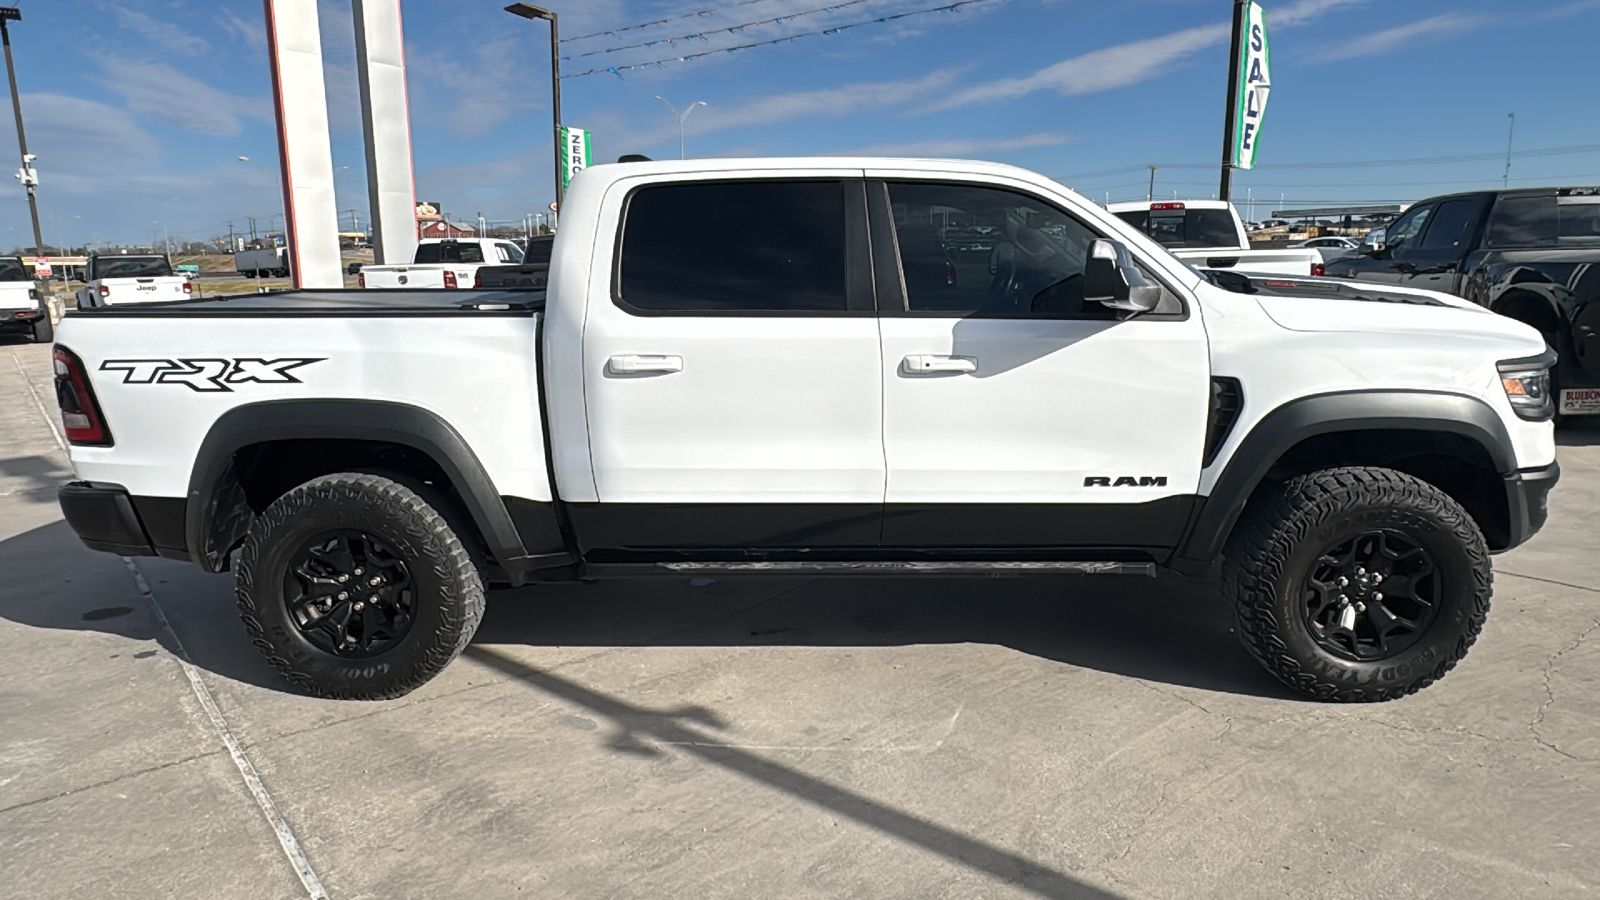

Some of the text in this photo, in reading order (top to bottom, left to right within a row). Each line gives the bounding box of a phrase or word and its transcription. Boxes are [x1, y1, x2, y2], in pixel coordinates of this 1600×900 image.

[1243, 24, 1265, 150] SALE
[572, 134, 582, 174] ZERO
[98, 358, 329, 392] TRX
[1083, 476, 1168, 487] RAM
